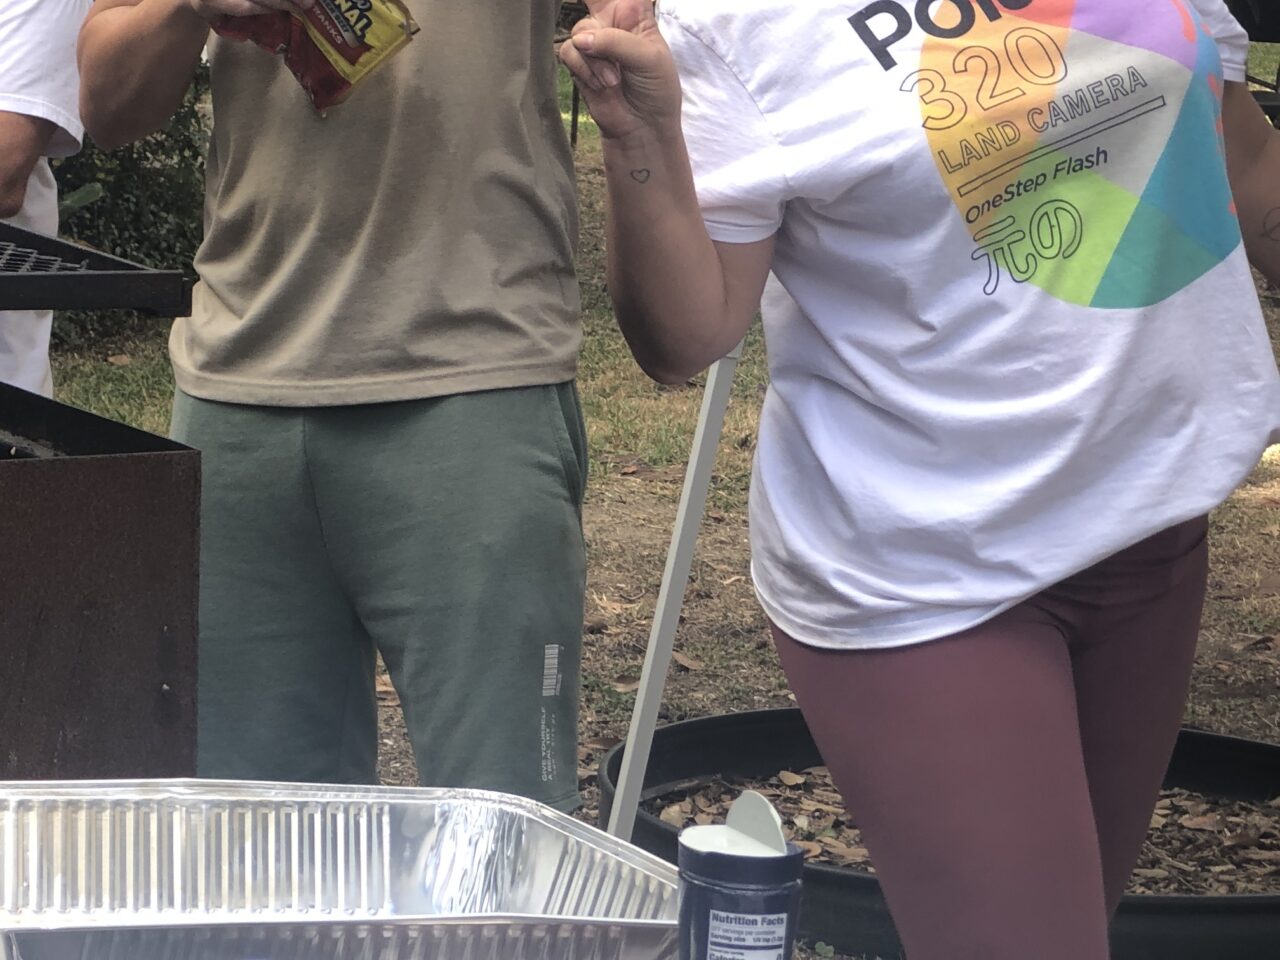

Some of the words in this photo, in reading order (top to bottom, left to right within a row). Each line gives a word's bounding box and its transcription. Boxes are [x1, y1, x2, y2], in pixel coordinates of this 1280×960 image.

[899, 27, 1068, 130] 320
[938, 120, 1021, 174] LAND
[1027, 66, 1147, 133] CAMERA
[966, 171, 1047, 224] OneStep
[1053, 146, 1109, 179] Flash
[711, 912, 758, 926] Nutrition
[760, 916, 785, 926] Facts
